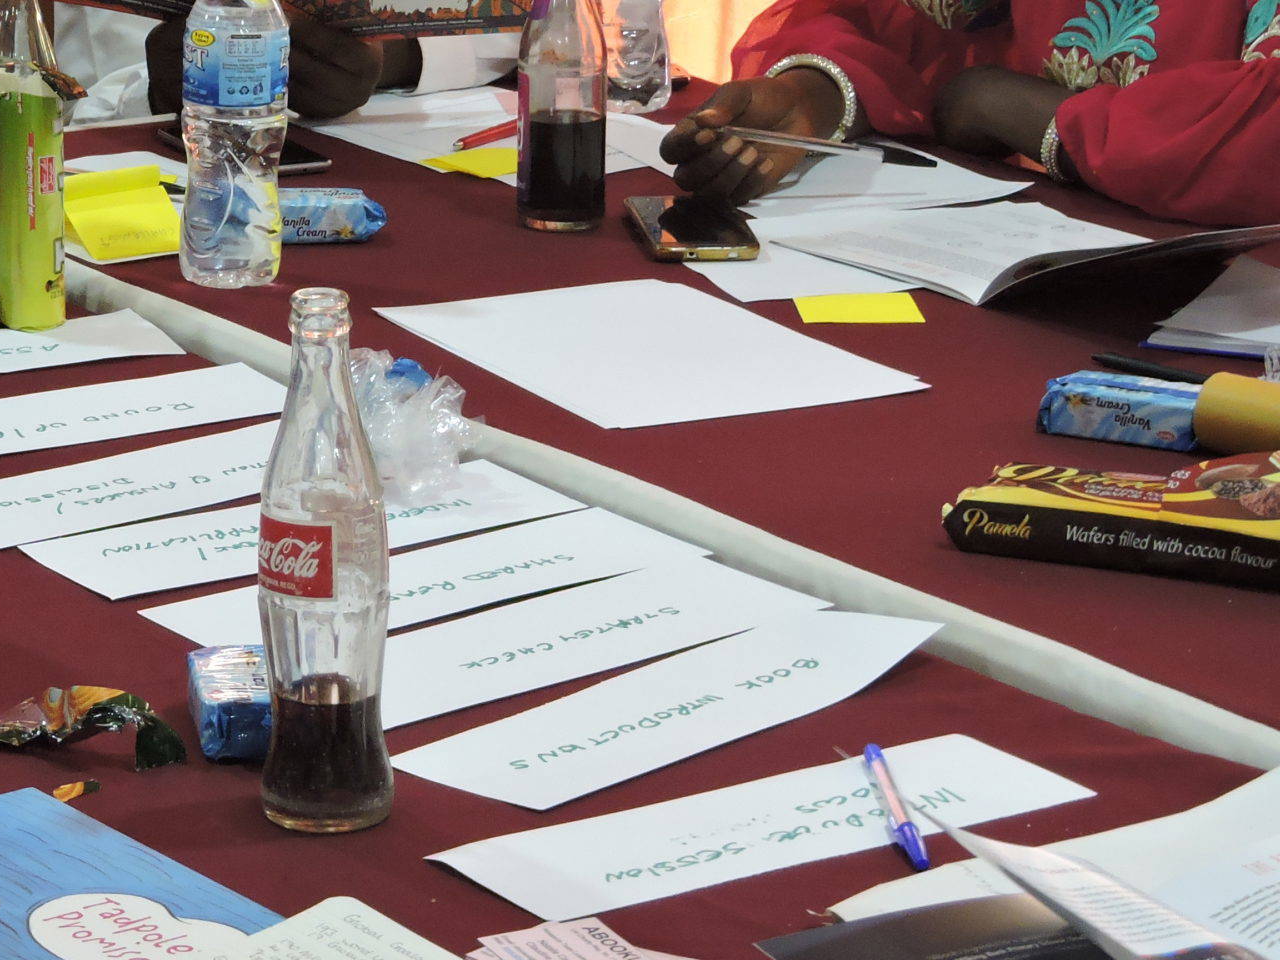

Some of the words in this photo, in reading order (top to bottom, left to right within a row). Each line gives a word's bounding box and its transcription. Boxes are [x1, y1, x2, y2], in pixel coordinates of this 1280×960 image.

[296, 227, 327, 238] Cream
[83, 402, 195, 424] ROUND
[1096, 397, 1131, 415] Cream
[1114, 414, 1152, 431] Vanilla
[962, 507, 1032, 540] Pamela
[1066, 524, 1116, 546] Wafers
[1118, 530, 1152, 551] filled
[1152, 537, 1183, 554] with
[1184, 543, 1226, 560] cocoa
[1230, 546, 1277, 569] flavour
[459, 642, 554, 669] CHECK
[734, 657, 820, 690] BOOK
[42, 911, 152, 960] Promis
[582, 926, 641, 960] ABOOK
